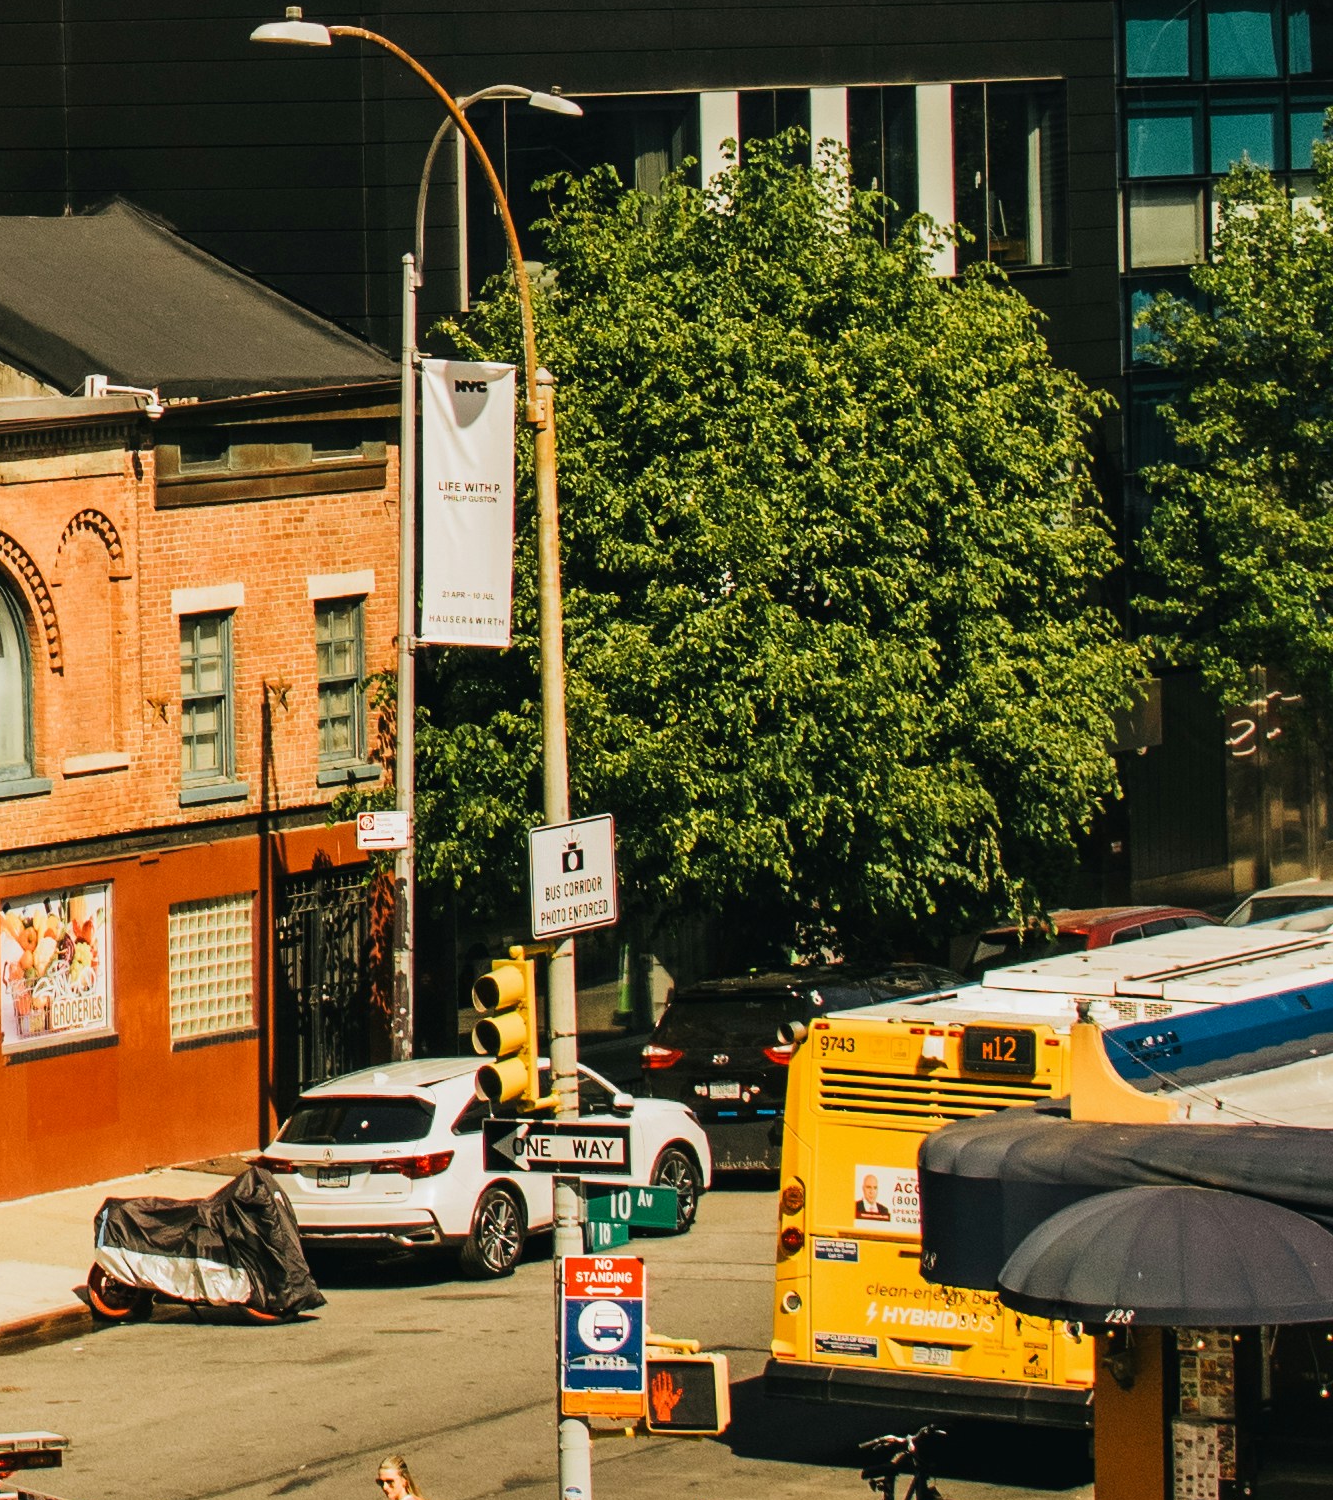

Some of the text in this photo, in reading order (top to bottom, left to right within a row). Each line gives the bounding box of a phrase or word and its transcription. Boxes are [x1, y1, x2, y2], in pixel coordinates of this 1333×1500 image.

[454, 379, 488, 394] NYC
[438, 481, 461, 492] LIFE
[464, 482, 492, 493] WITH
[429, 614, 466, 624] HAUSER
[545, 876, 602, 901] BUS CORRIDOR
[540, 899, 608, 926] PHOTO ENFORCED
[53, 995, 103, 1026] GROCERIES
[819, 1035, 856, 1053] 9743
[512, 1137, 615, 1159] ONE WAY
[610, 1189, 654, 1220] 10 Av
[594, 1259, 614, 1271] NO
[575, 1271, 633, 1284] STANDING
